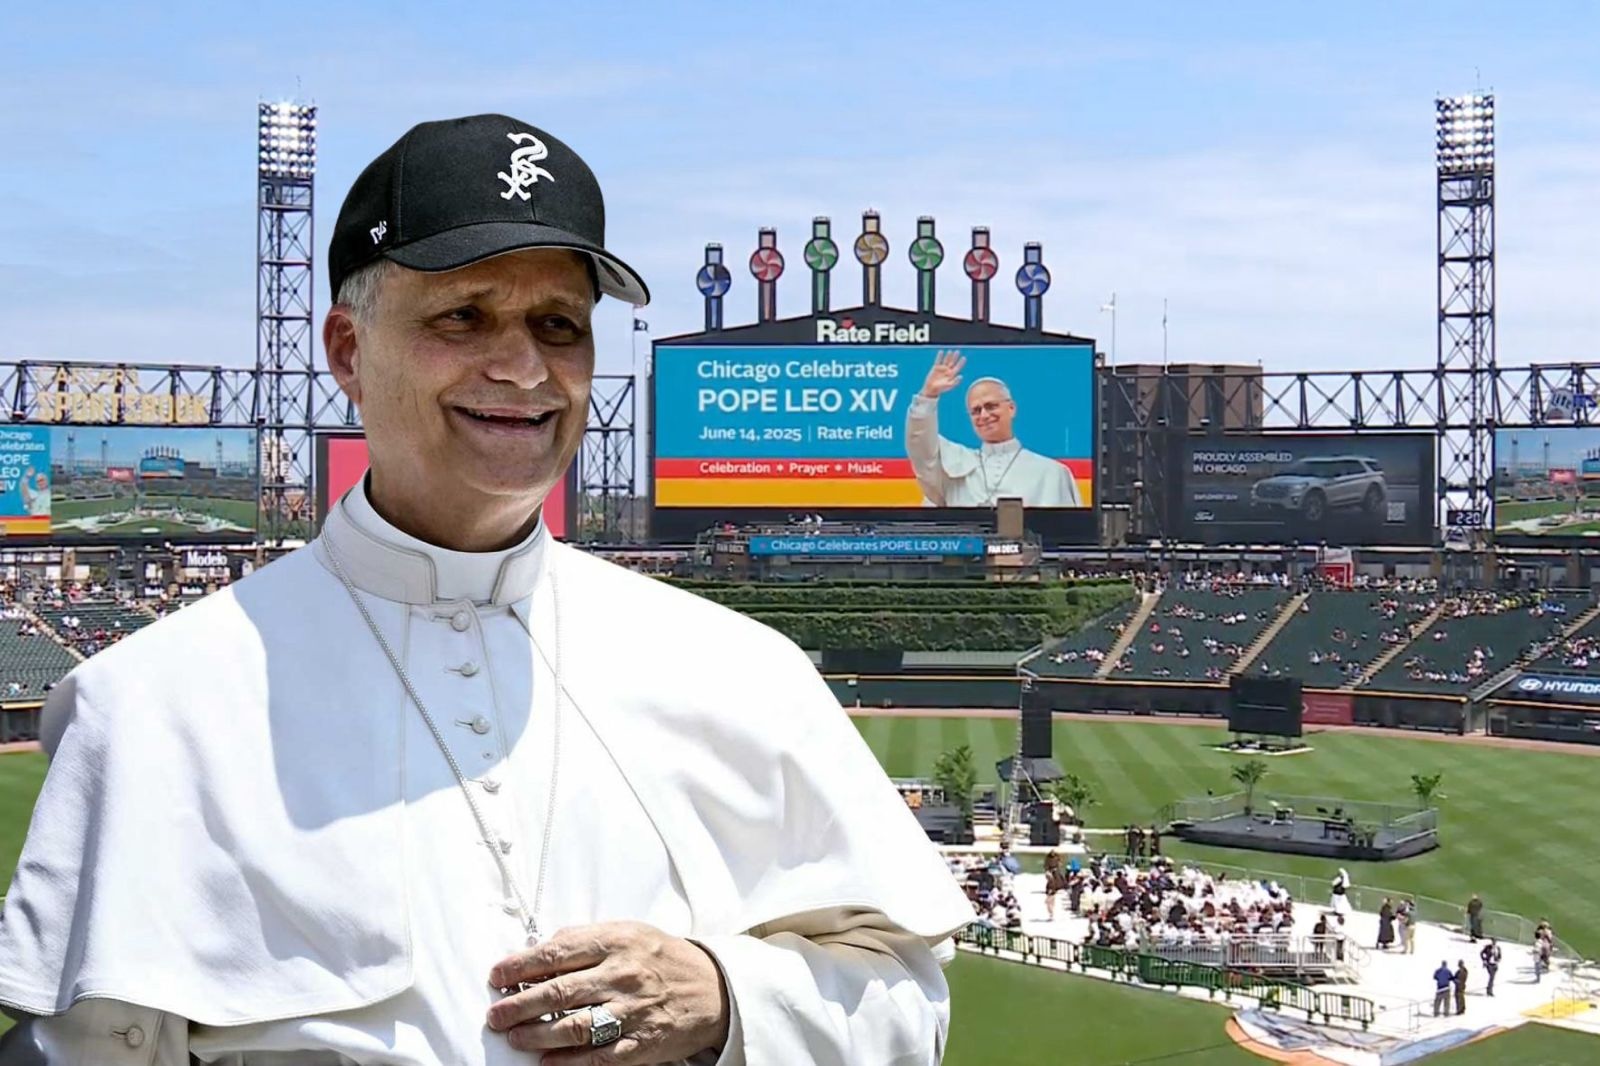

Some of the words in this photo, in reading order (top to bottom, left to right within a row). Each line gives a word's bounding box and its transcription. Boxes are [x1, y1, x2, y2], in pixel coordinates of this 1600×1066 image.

[816, 319, 871, 343] Rate
[875, 323, 930, 343] Field
[697, 360, 781, 383] Chicago
[785, 360, 899, 378] Celebrates
[698, 388, 778, 412] POPE
[785, 388, 842, 412] LEO
[849, 388, 899, 412] XIV
[699, 426, 736, 440] June
[739, 427, 761, 442] 14,
[763, 428, 802, 442] 2025
[817, 426, 851, 440] Rate
[856, 426, 893, 440] Field
[1193, 453, 1237, 462] PROUDLY
[1239, 453, 1292, 462] ASSEMBLED
[700, 462, 771, 474] Celebration
[789, 463, 830, 476] Prayer
[848, 463, 883, 474] Music
[1193, 465, 1203, 473] IN
[771, 540, 816, 552] Chicago
[817, 540, 878, 551] Celebrates
[879, 540, 913, 551] POPE
[914, 540, 938, 551] LEO
[940, 540, 961, 551] XIV
[187, 551, 228, 567] Modelo
